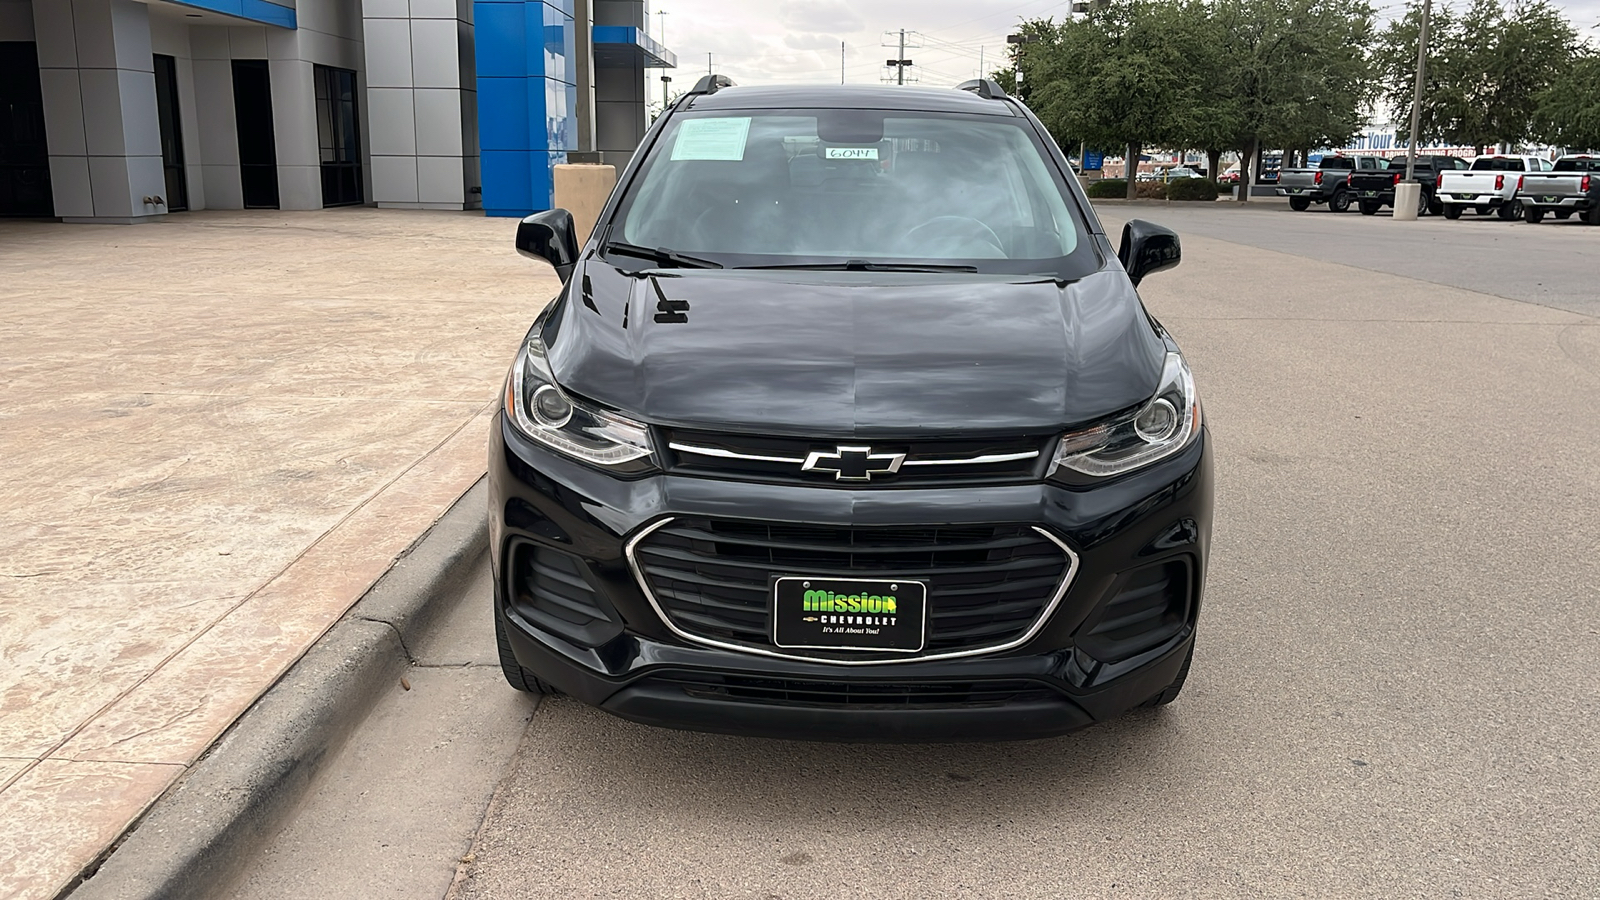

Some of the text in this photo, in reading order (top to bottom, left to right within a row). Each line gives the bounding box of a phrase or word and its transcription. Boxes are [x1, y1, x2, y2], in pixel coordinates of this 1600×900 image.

[1368, 132, 1392, 149] Your
[830, 149, 870, 158] 6044
[821, 615, 897, 626] CHEVROLET
